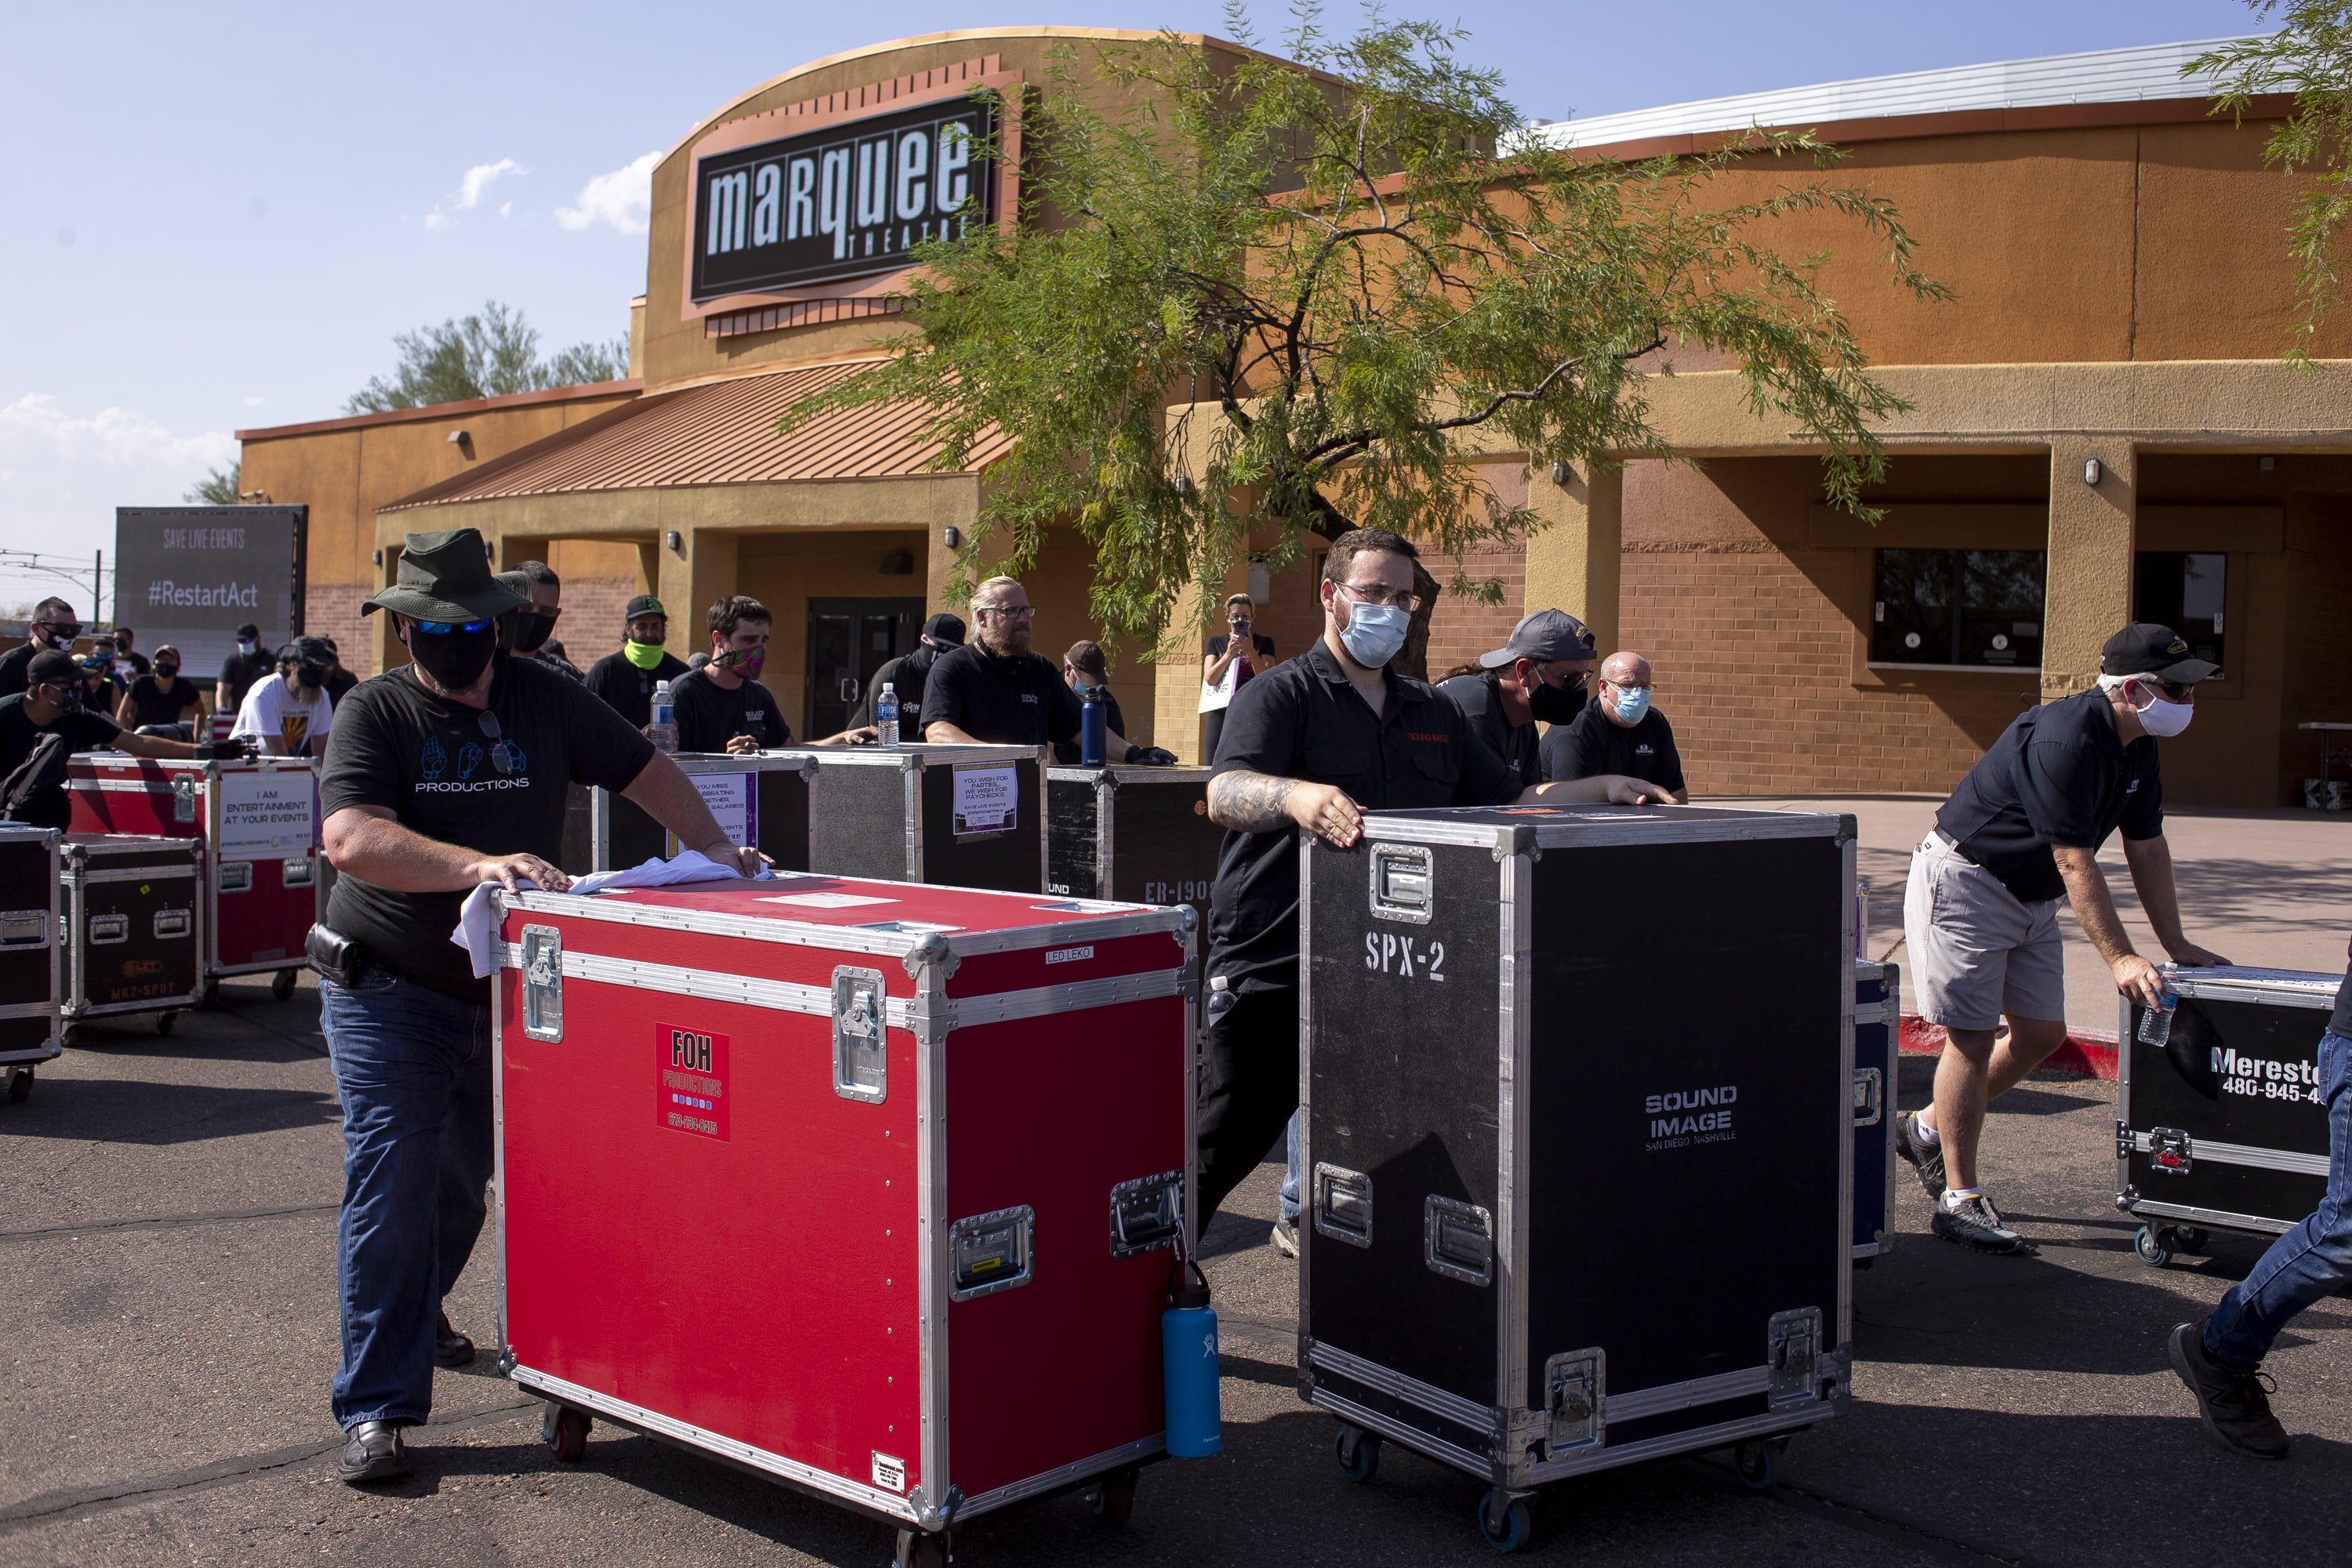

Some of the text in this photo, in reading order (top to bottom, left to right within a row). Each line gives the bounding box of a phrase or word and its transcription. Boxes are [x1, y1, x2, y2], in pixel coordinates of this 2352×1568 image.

[163, 528, 245, 549] SAVE LIVE EVENTS
[149, 580, 259, 608] #RestartAct
[416, 778, 529, 793] PRODUCTIONS
[227, 801, 307, 812] ENTERTAINMENT
[224, 813, 309, 825] AT YOUR EVENTS
[1048, 883, 1069, 895] UND
[1047, 947, 1091, 962] LED LEKO
[1366, 931, 1444, 982] SPX-2
[672, 1029, 713, 1073] FOH
[662, 1069, 721, 1098] PRODUCTIONS
[2223, 1076, 2326, 1105] 480-945-4
[1646, 1085, 1737, 1113] SOUND
[667, 1112, 717, 1135] 623-234-8475
[1651, 1110, 1732, 1138] IMAGE
[1646, 1130, 1737, 1151] SAN DIEGO NASHVILLE
